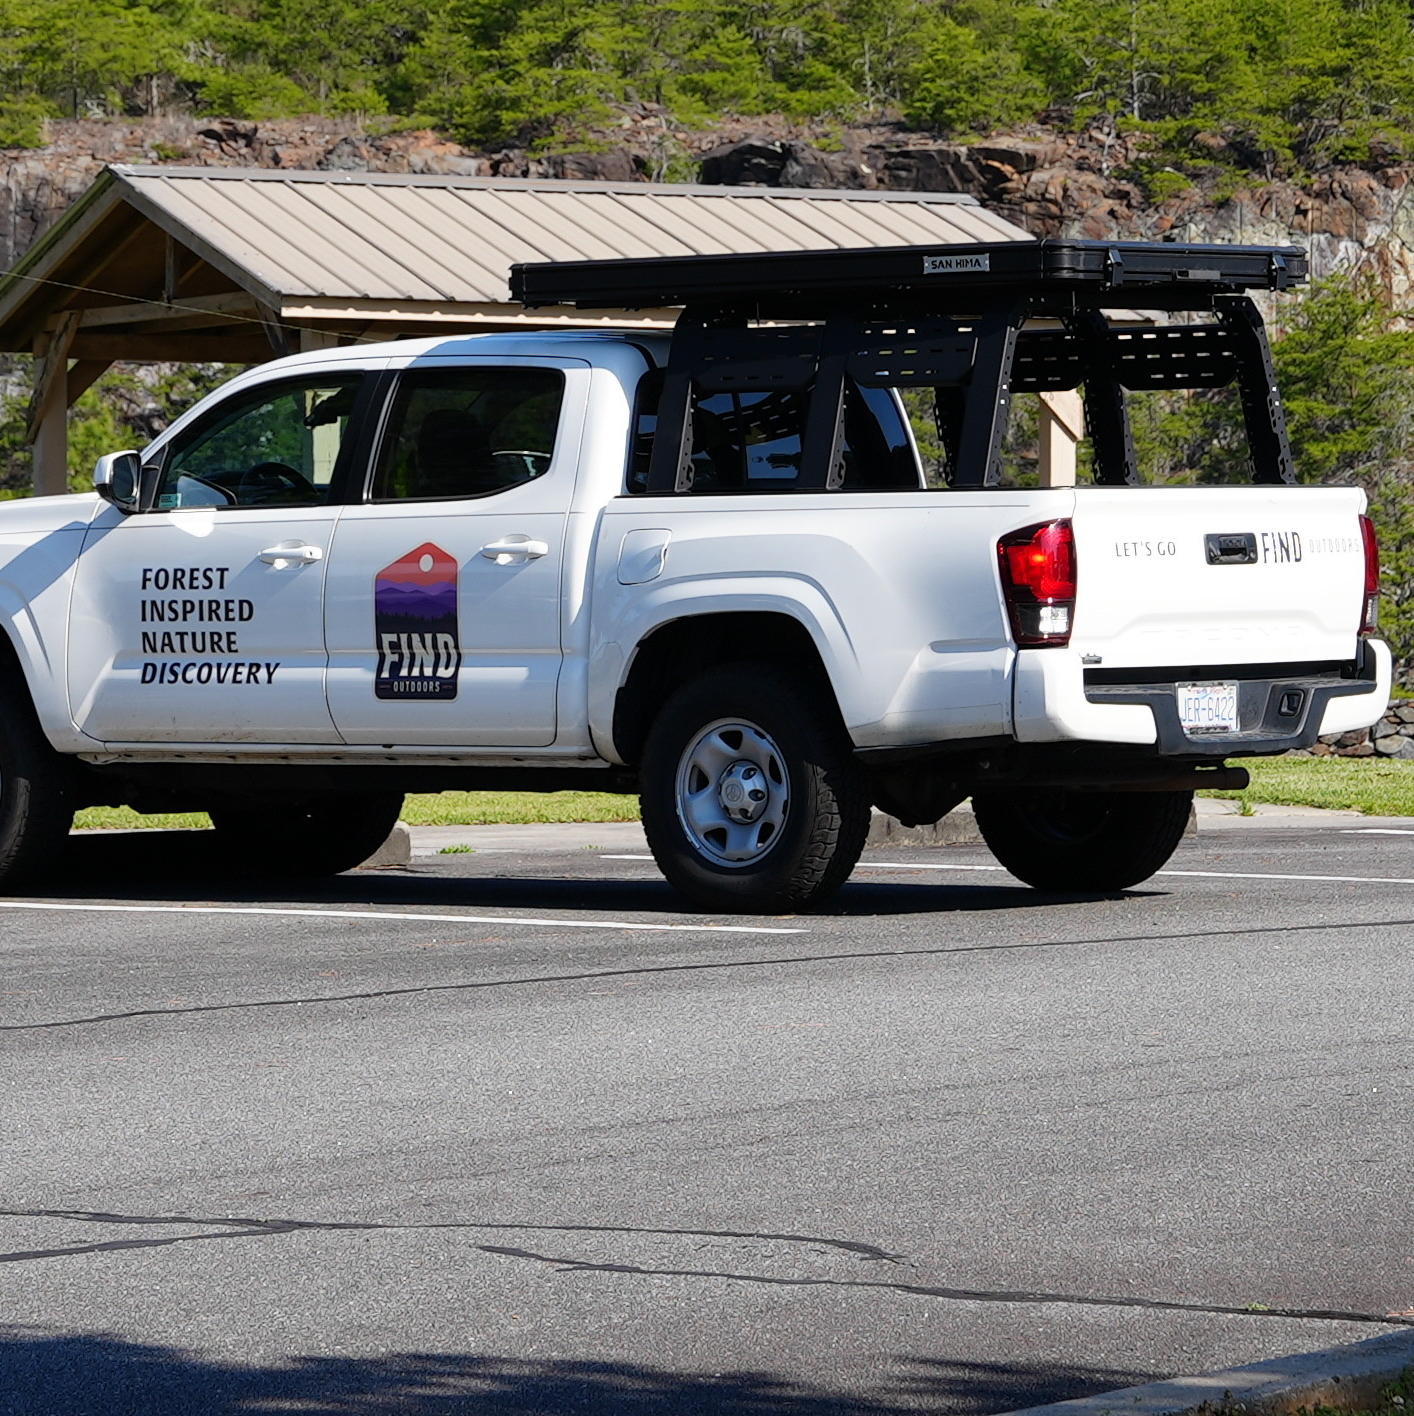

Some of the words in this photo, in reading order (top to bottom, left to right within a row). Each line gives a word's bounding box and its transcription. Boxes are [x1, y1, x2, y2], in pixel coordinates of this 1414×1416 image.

[931, 259, 952, 270] SAN
[955, 258, 982, 268] HIMA
[1115, 541, 1152, 557] LET'S
[1157, 541, 1176, 556] GO
[1261, 531, 1302, 563] FIND
[1308, 538, 1360, 553] OUTDOORS
[141, 567, 229, 590] FOREST
[140, 599, 254, 622] INSPIRED
[141, 631, 239, 653] NATURE
[380, 633, 458, 679] FIND
[140, 662, 281, 684] DISCOVERY
[393, 681, 441, 693] OUTDOORS
[1181, 696, 1235, 722] JER-6422
